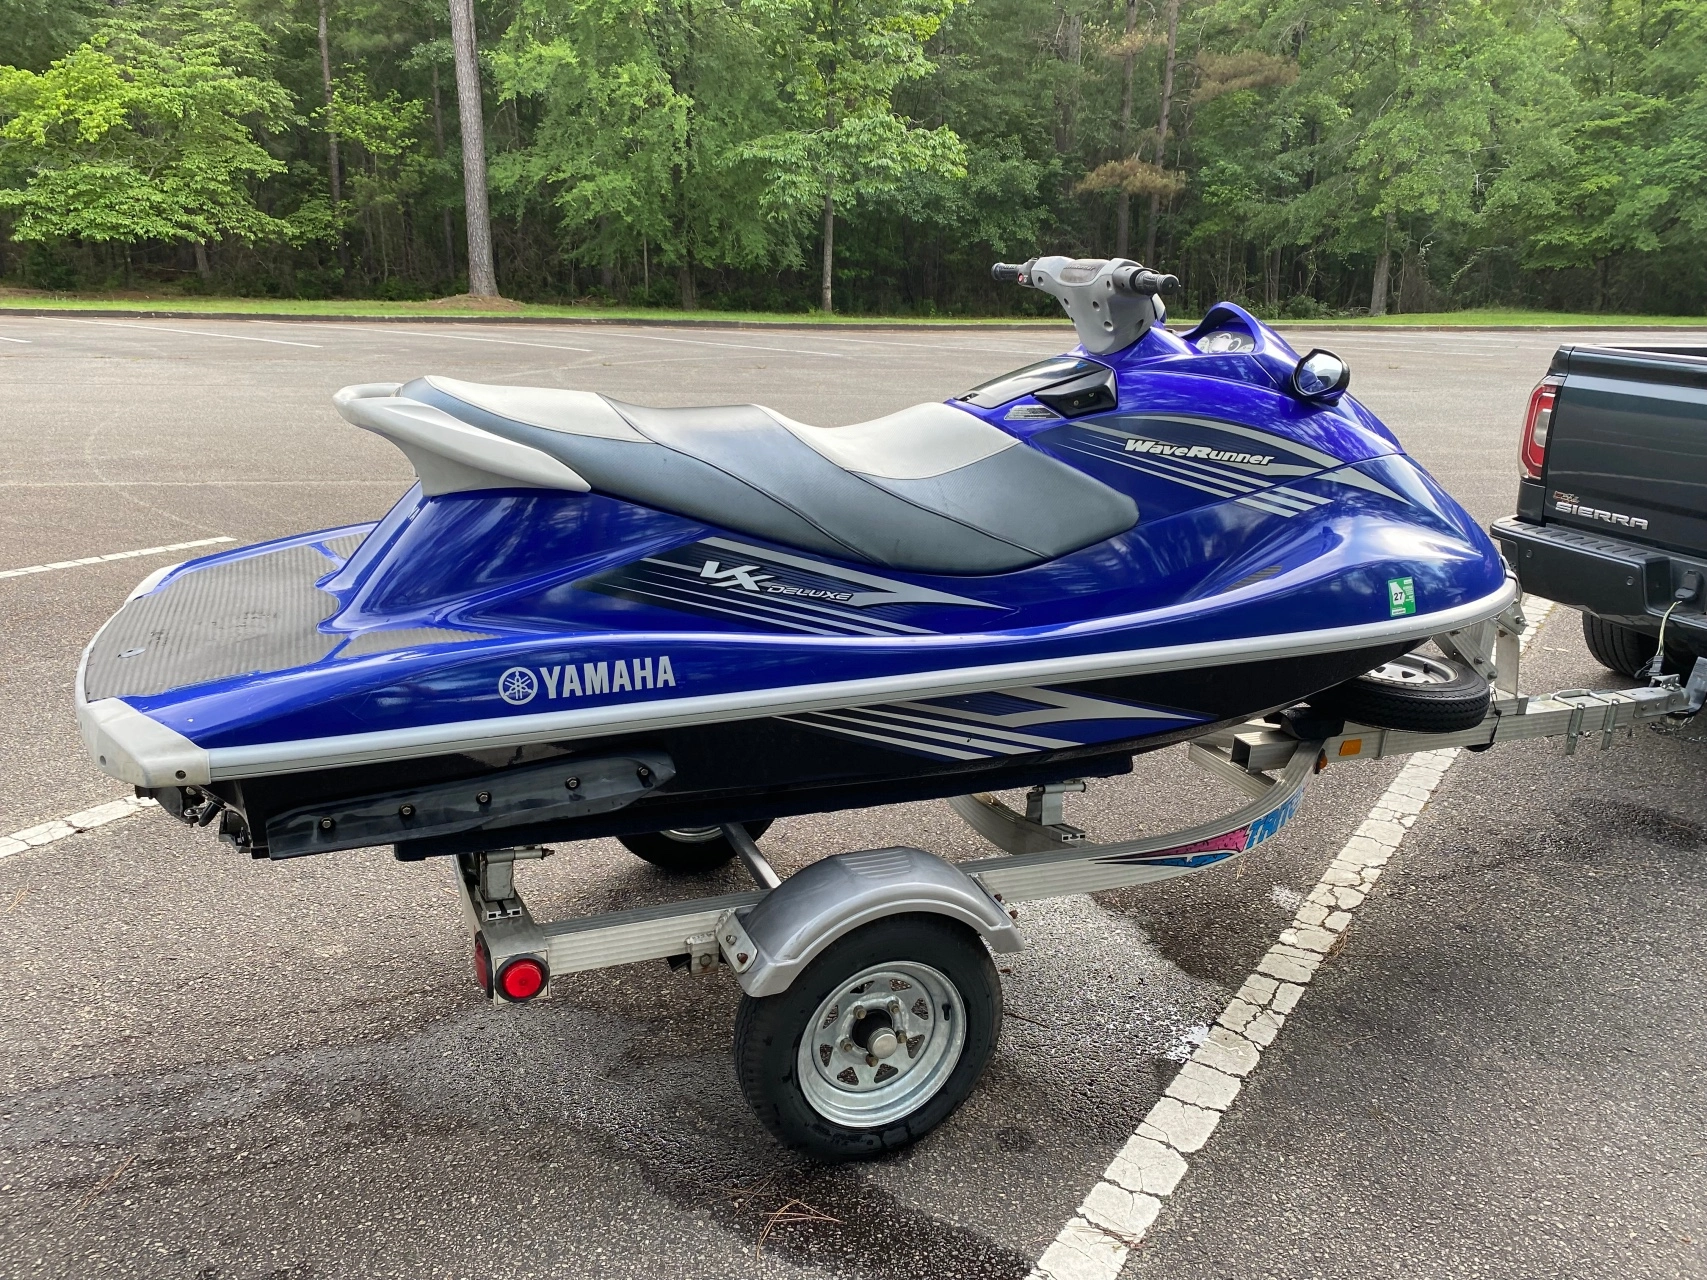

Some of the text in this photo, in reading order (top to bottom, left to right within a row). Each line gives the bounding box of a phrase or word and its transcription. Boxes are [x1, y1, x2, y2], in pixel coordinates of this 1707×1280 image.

[1124, 438, 1275, 466] WaveRunner
[1555, 501, 1649, 530] SIERRA
[700, 560, 854, 601] VX DELUXE
[1393, 592, 1404, 601] 27
[539, 656, 676, 699] YAMAHA
